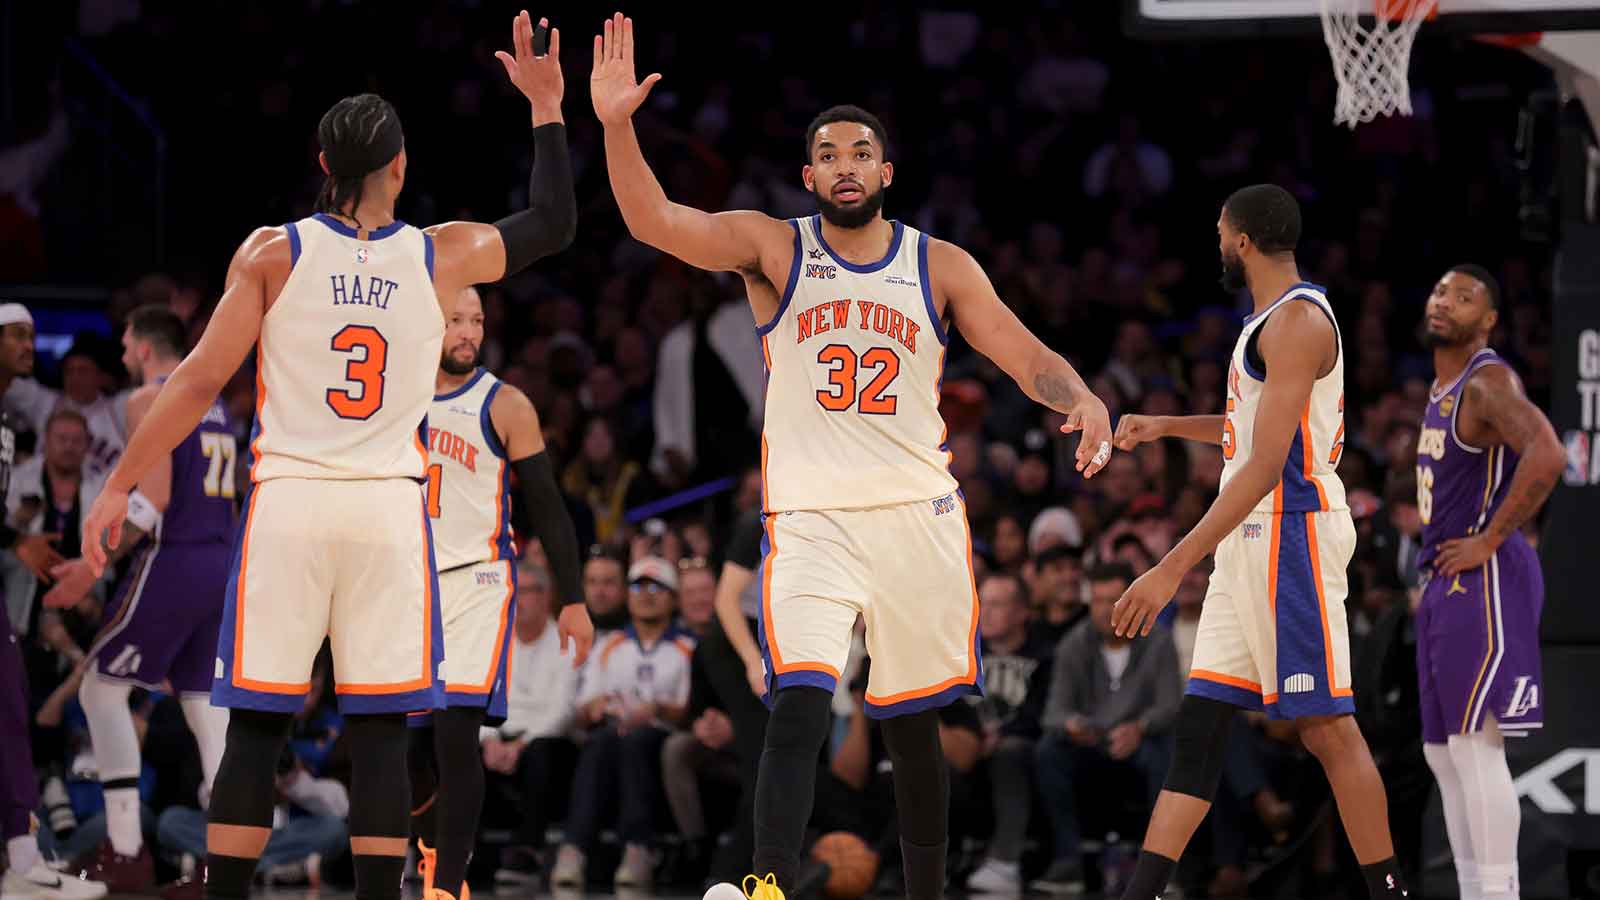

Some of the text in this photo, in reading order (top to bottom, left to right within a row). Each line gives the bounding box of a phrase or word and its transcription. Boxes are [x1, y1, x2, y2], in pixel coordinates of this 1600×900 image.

[330, 274, 399, 311] HART
[805, 263, 837, 280] NYC
[797, 299, 921, 354] NEW YORK
[326, 323, 389, 421] 3
[816, 343, 900, 415] 32
[200, 432, 238, 497] 77
[428, 426, 479, 473] YORK
[1500, 675, 1540, 719] LA
